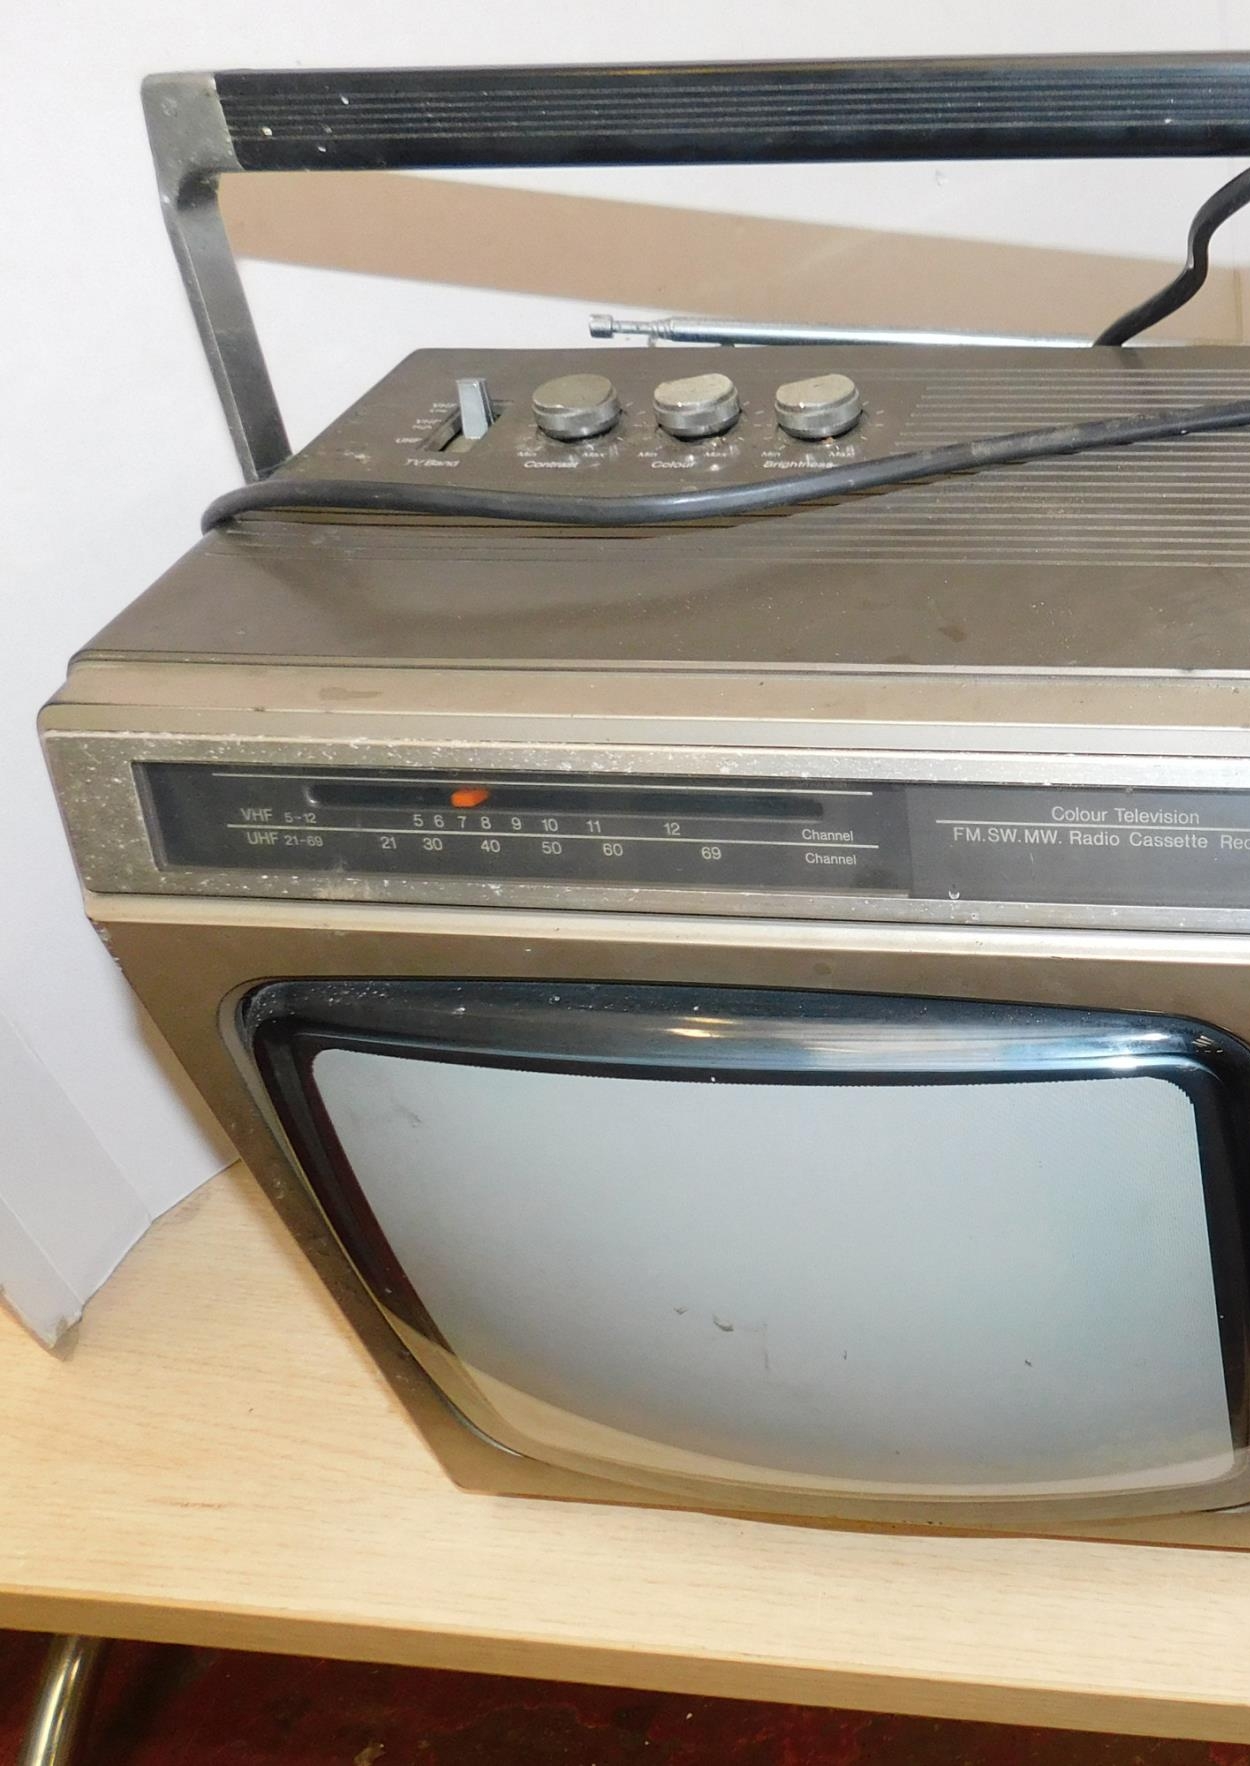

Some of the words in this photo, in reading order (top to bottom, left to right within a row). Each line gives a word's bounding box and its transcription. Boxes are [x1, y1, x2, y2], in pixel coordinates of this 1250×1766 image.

[424, 459, 460, 467] Band
[524, 460, 578, 469] Contrast
[651, 460, 696, 469] Colour
[764, 460, 835, 469] Brightness
[240, 808, 273, 822] VHF
[284, 812, 317, 824] 5-12
[1051, 806, 1108, 822] Colour
[1114, 807, 1200, 825] Television
[413, 814, 424, 827] 5
[434, 815, 445, 828] 6
[458, 815, 468, 829] 7
[480, 816, 491, 829] 8
[511, 817, 522, 830] 9
[542, 819, 559, 832] 10
[587, 820, 602, 833] 11
[664, 823, 681, 836] 12
[248, 832, 279, 846] UHF
[284, 834, 324, 847] 21-69
[802, 828, 854, 842] Channel
[1069, 830, 1121, 847] Radio
[1129, 831, 1208, 849] Cassette
[380, 835, 397, 849] 21
[423, 837, 443, 851] 30
[480, 839, 501, 853] 40
[541, 841, 562, 855] 50
[603, 843, 624, 857] 60
[701, 847, 722, 861] 69
[805, 852, 857, 866] Channel
